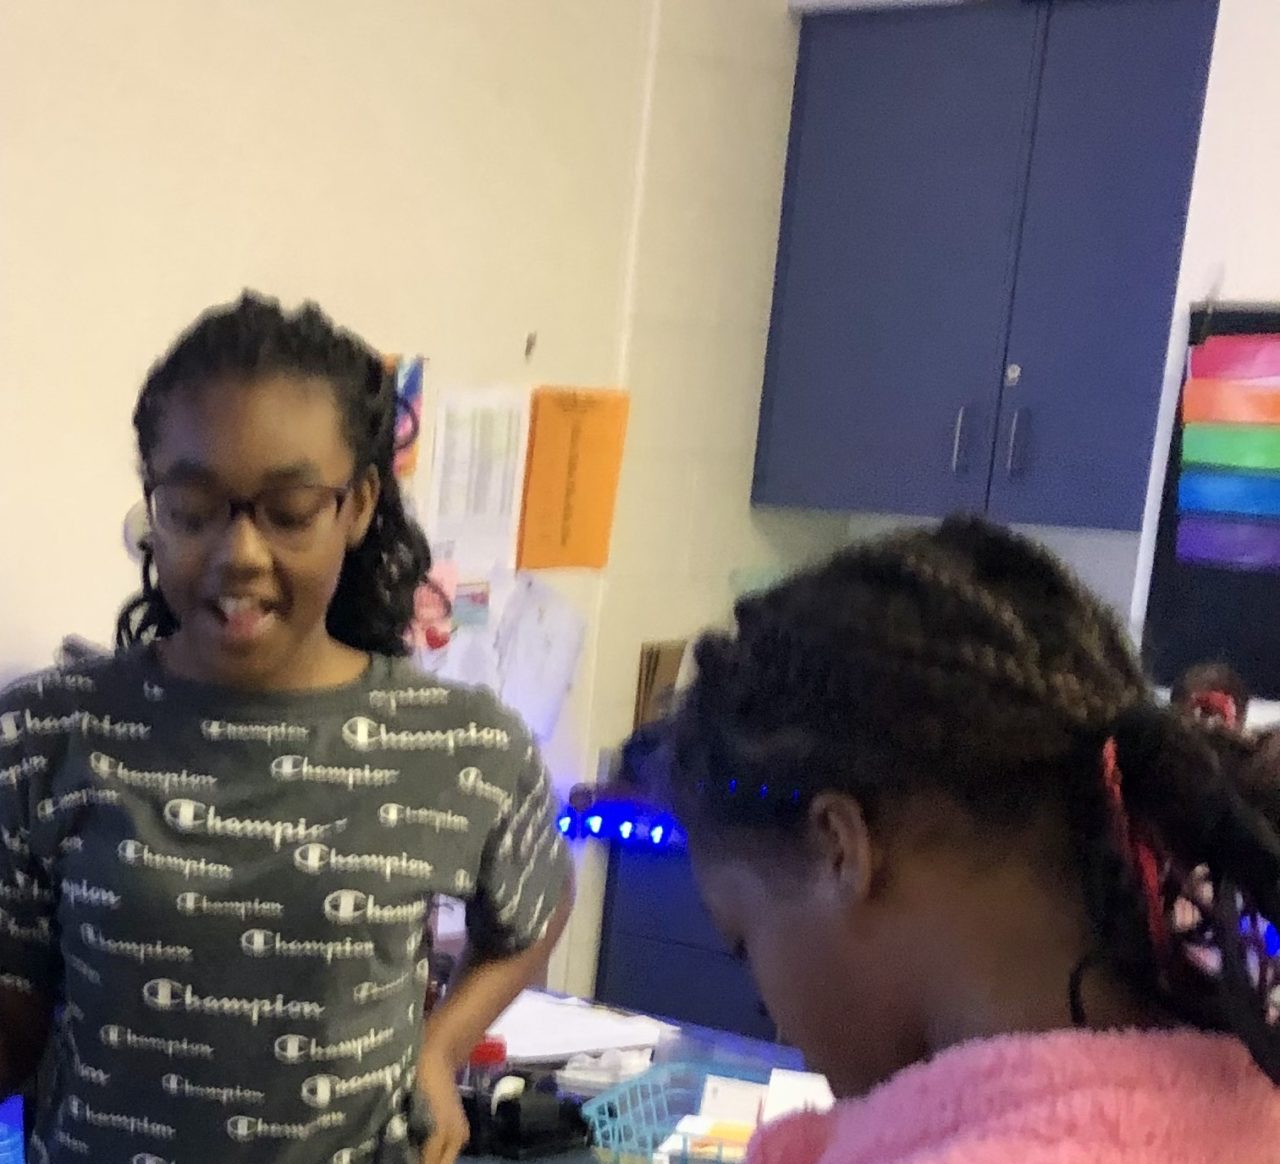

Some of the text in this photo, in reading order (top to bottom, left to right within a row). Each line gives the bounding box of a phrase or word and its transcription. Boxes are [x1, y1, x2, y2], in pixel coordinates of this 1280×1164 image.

[201, 719, 310, 744] Champion
[342, 716, 511, 756] Champion
[91, 752, 217, 793] Champion
[271, 755, 402, 791] Champion
[118, 839, 234, 880] Champion
[294, 843, 434, 882] Champion
[176, 892, 285, 921] Champion
[240, 928, 376, 965] Champion
[143, 977, 325, 1026] Champion
[99, 1024, 215, 1059] Champion
[161, 1073, 266, 1104] Champion
